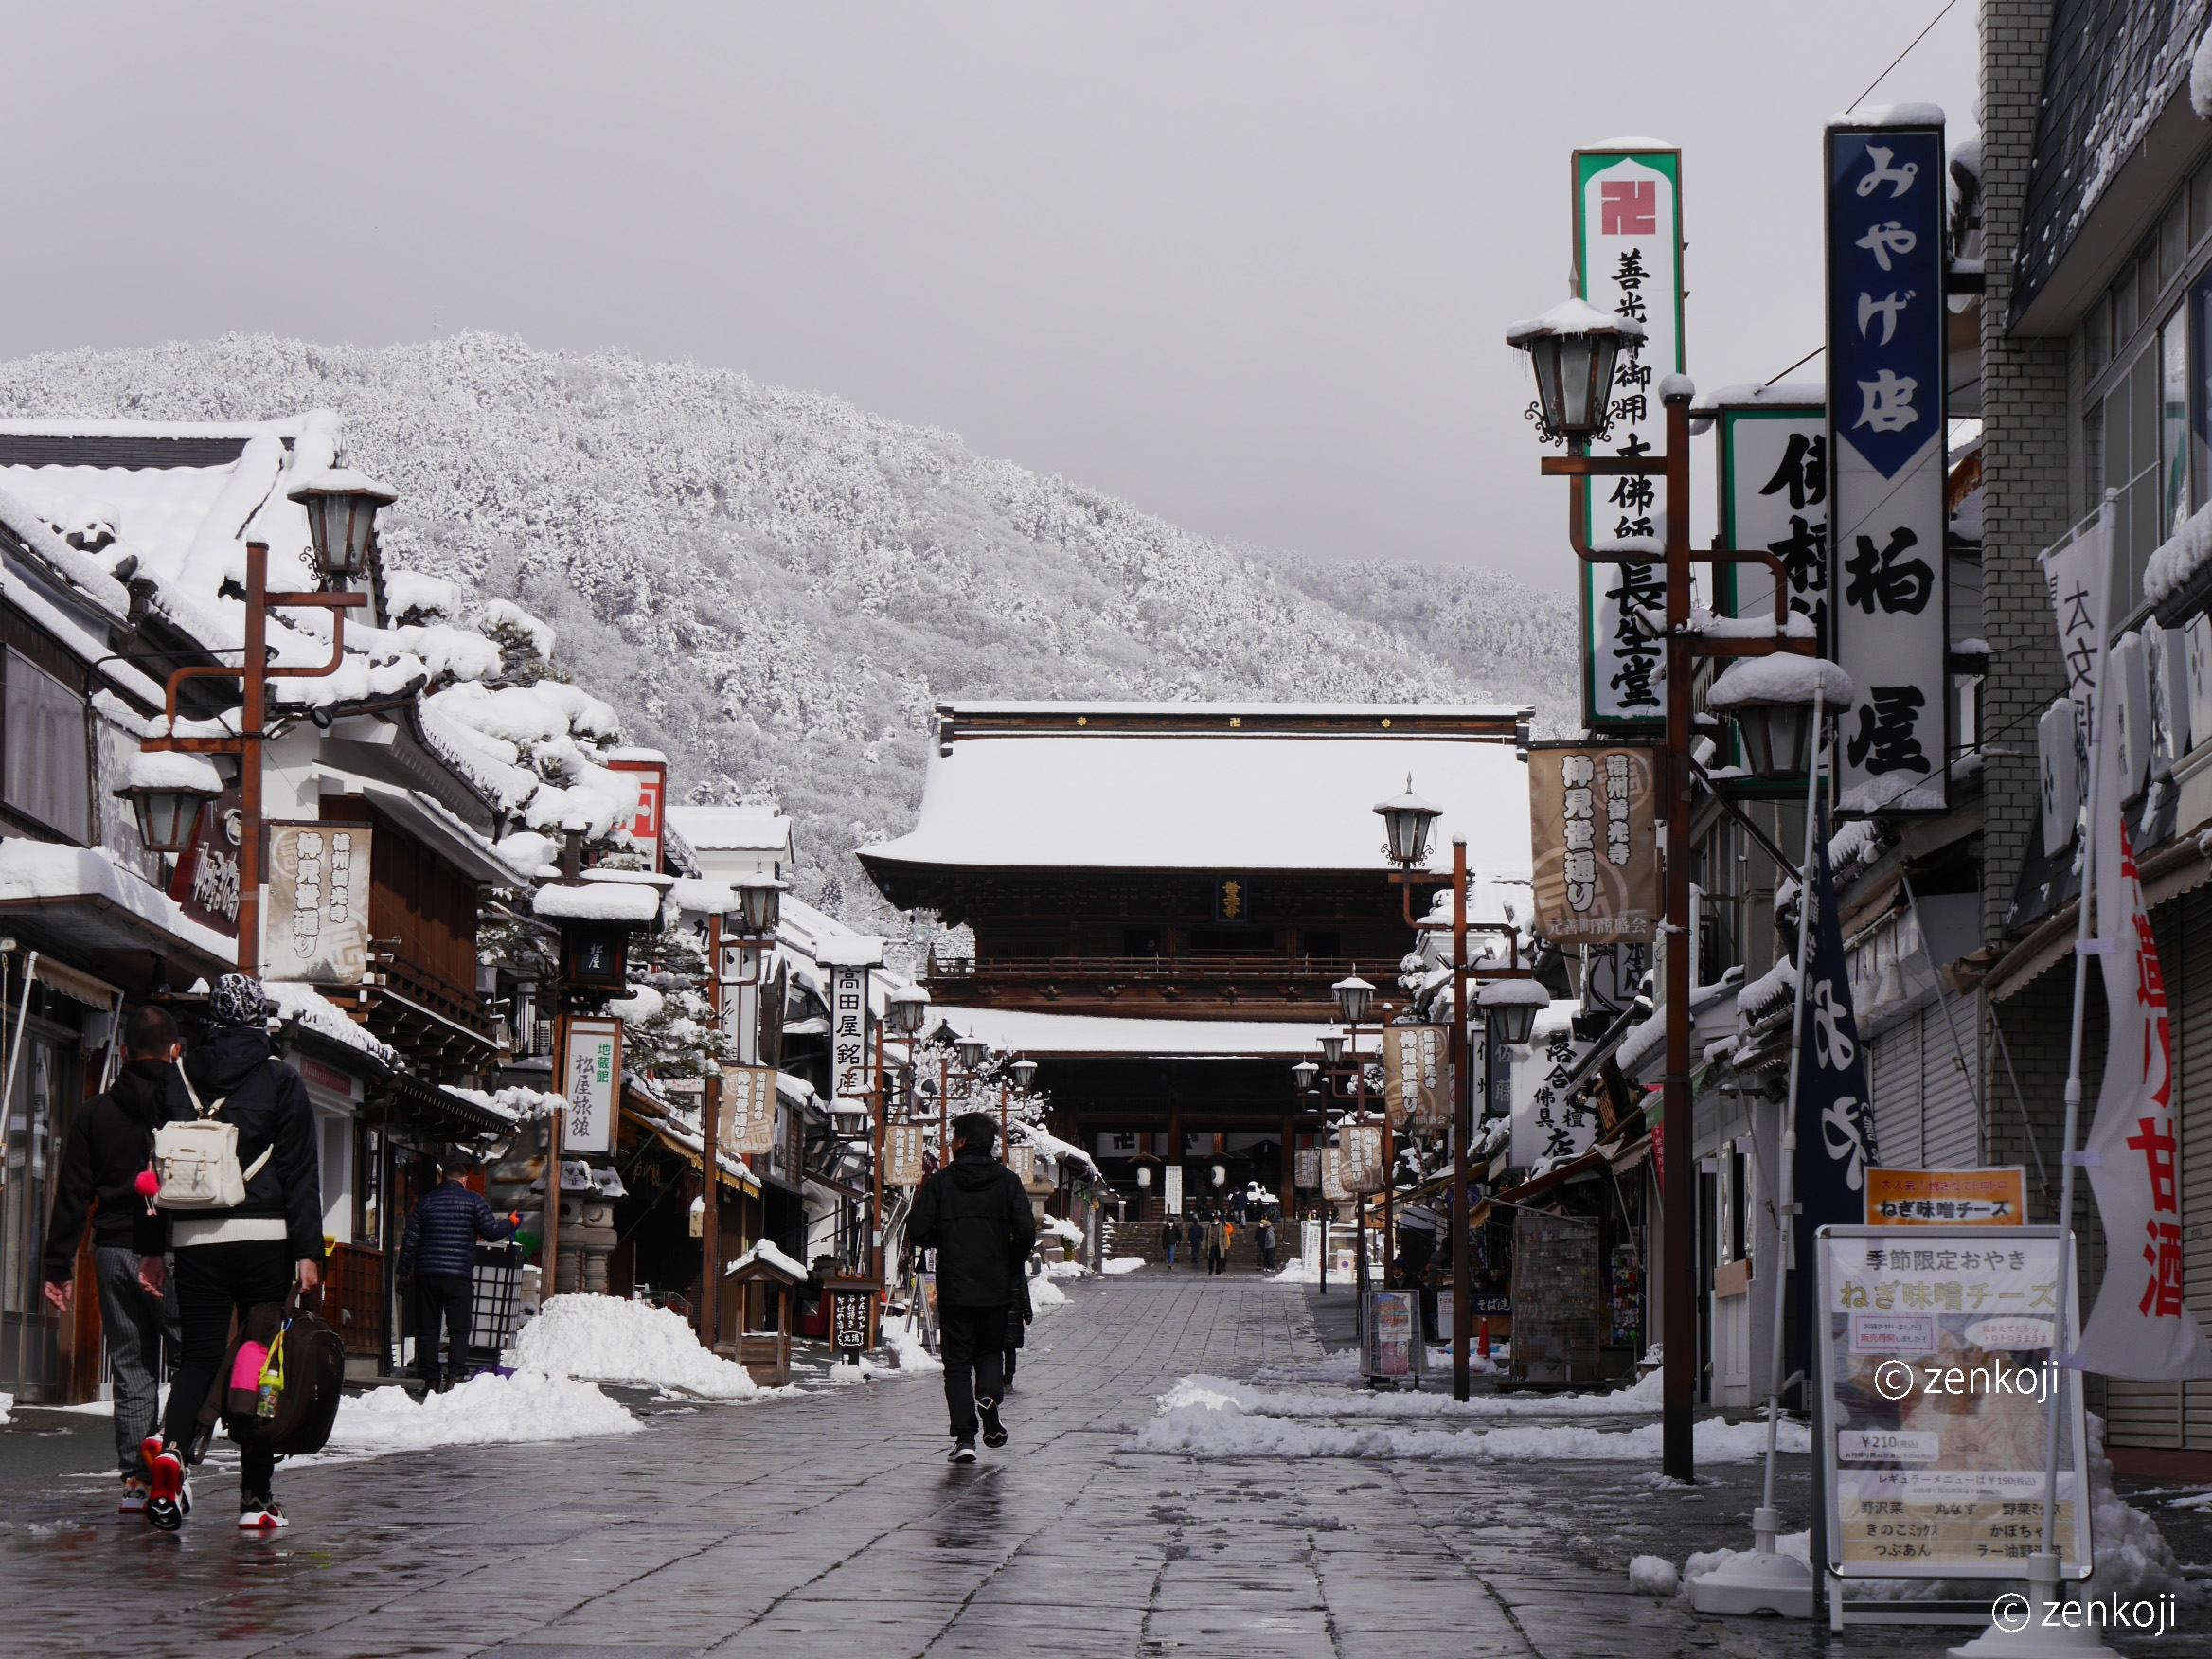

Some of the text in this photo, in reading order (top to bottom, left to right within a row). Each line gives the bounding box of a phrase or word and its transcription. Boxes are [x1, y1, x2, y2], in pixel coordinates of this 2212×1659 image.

[1851, 144, 1918, 433] みやげ店
[1845, 526, 1935, 775] 柏屋
[1561, 755, 1596, 913] 仲見世通り
[1605, 754, 1631, 865] 信州善光寺
[294, 831, 324, 958] 仲見世通り
[330, 833, 351, 924] 信州善光寺
[1548, 917, 1647, 936] 元善町商盛会
[596, 1044, 611, 1083] 地蔵館
[1400, 1030, 1418, 1113] 仲見世通り
[1880, 1199, 2009, 1219] ねぎ味噌チーズ
[1866, 1249, 2025, 1272] 季節限定おやき
[1840, 1280, 2057, 1311] ねぎ味噌チーズ
[1861, 1501, 1904, 1515] 野沢菜
[1935, 1502, 1977, 1515] 丸なす
[1874, 1544, 1931, 1557] つぶあん
